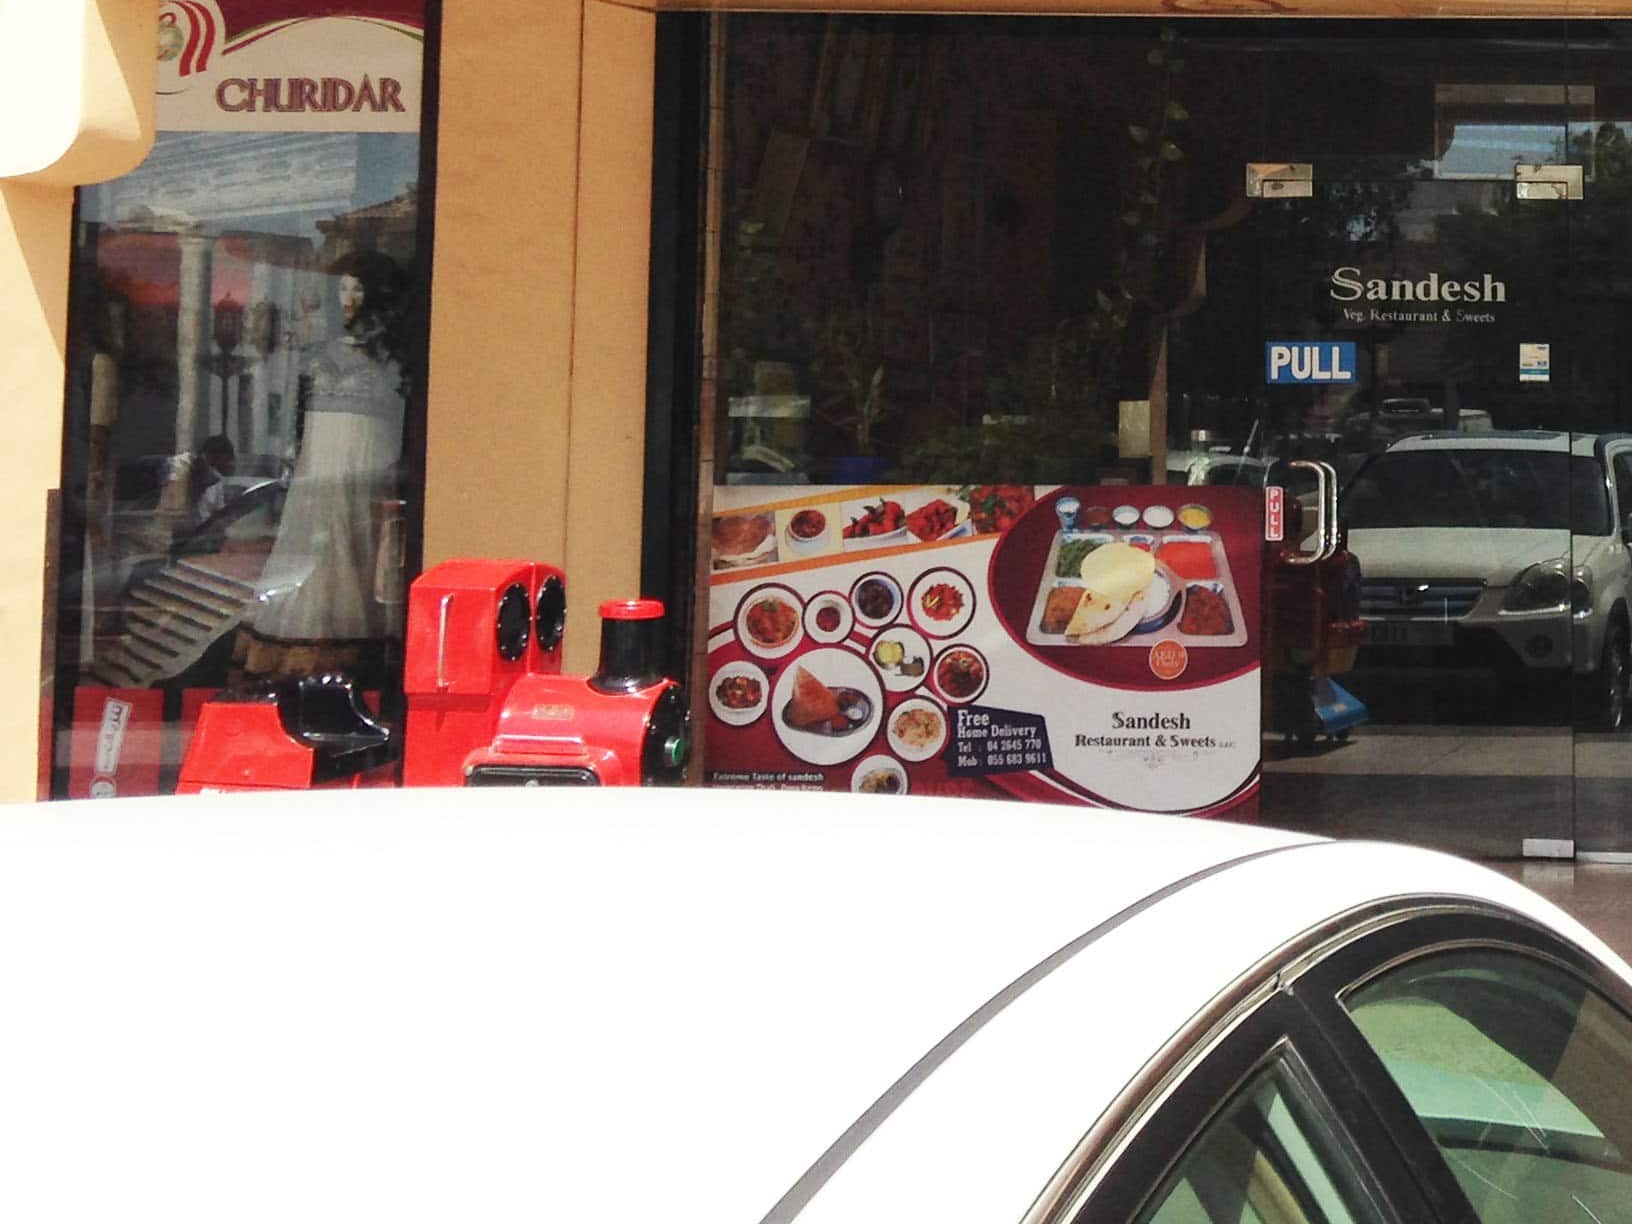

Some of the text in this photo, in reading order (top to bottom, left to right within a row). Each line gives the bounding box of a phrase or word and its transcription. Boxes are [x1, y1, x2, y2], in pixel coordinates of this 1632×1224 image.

[214, 72, 406, 113] CHURIDAR
[1329, 266, 1507, 303] Sandesh
[1370, 307, 1438, 322] Restaurant
[1441, 308, 1452, 322] &
[1455, 308, 1497, 324] Sweets
[1270, 345, 1352, 381] PULL
[1269, 488, 1281, 538] PULL
[957, 708, 990, 727] Free
[1111, 711, 1191, 730] Sandesh
[957, 724, 1037, 738] Home Delivery
[958, 741, 972, 753] Tel
[1074, 733, 1151, 748] Restaurant
[1154, 733, 1167, 748] &
[1169, 733, 1217, 749] Sweets
[957, 755, 978, 767] Mob
